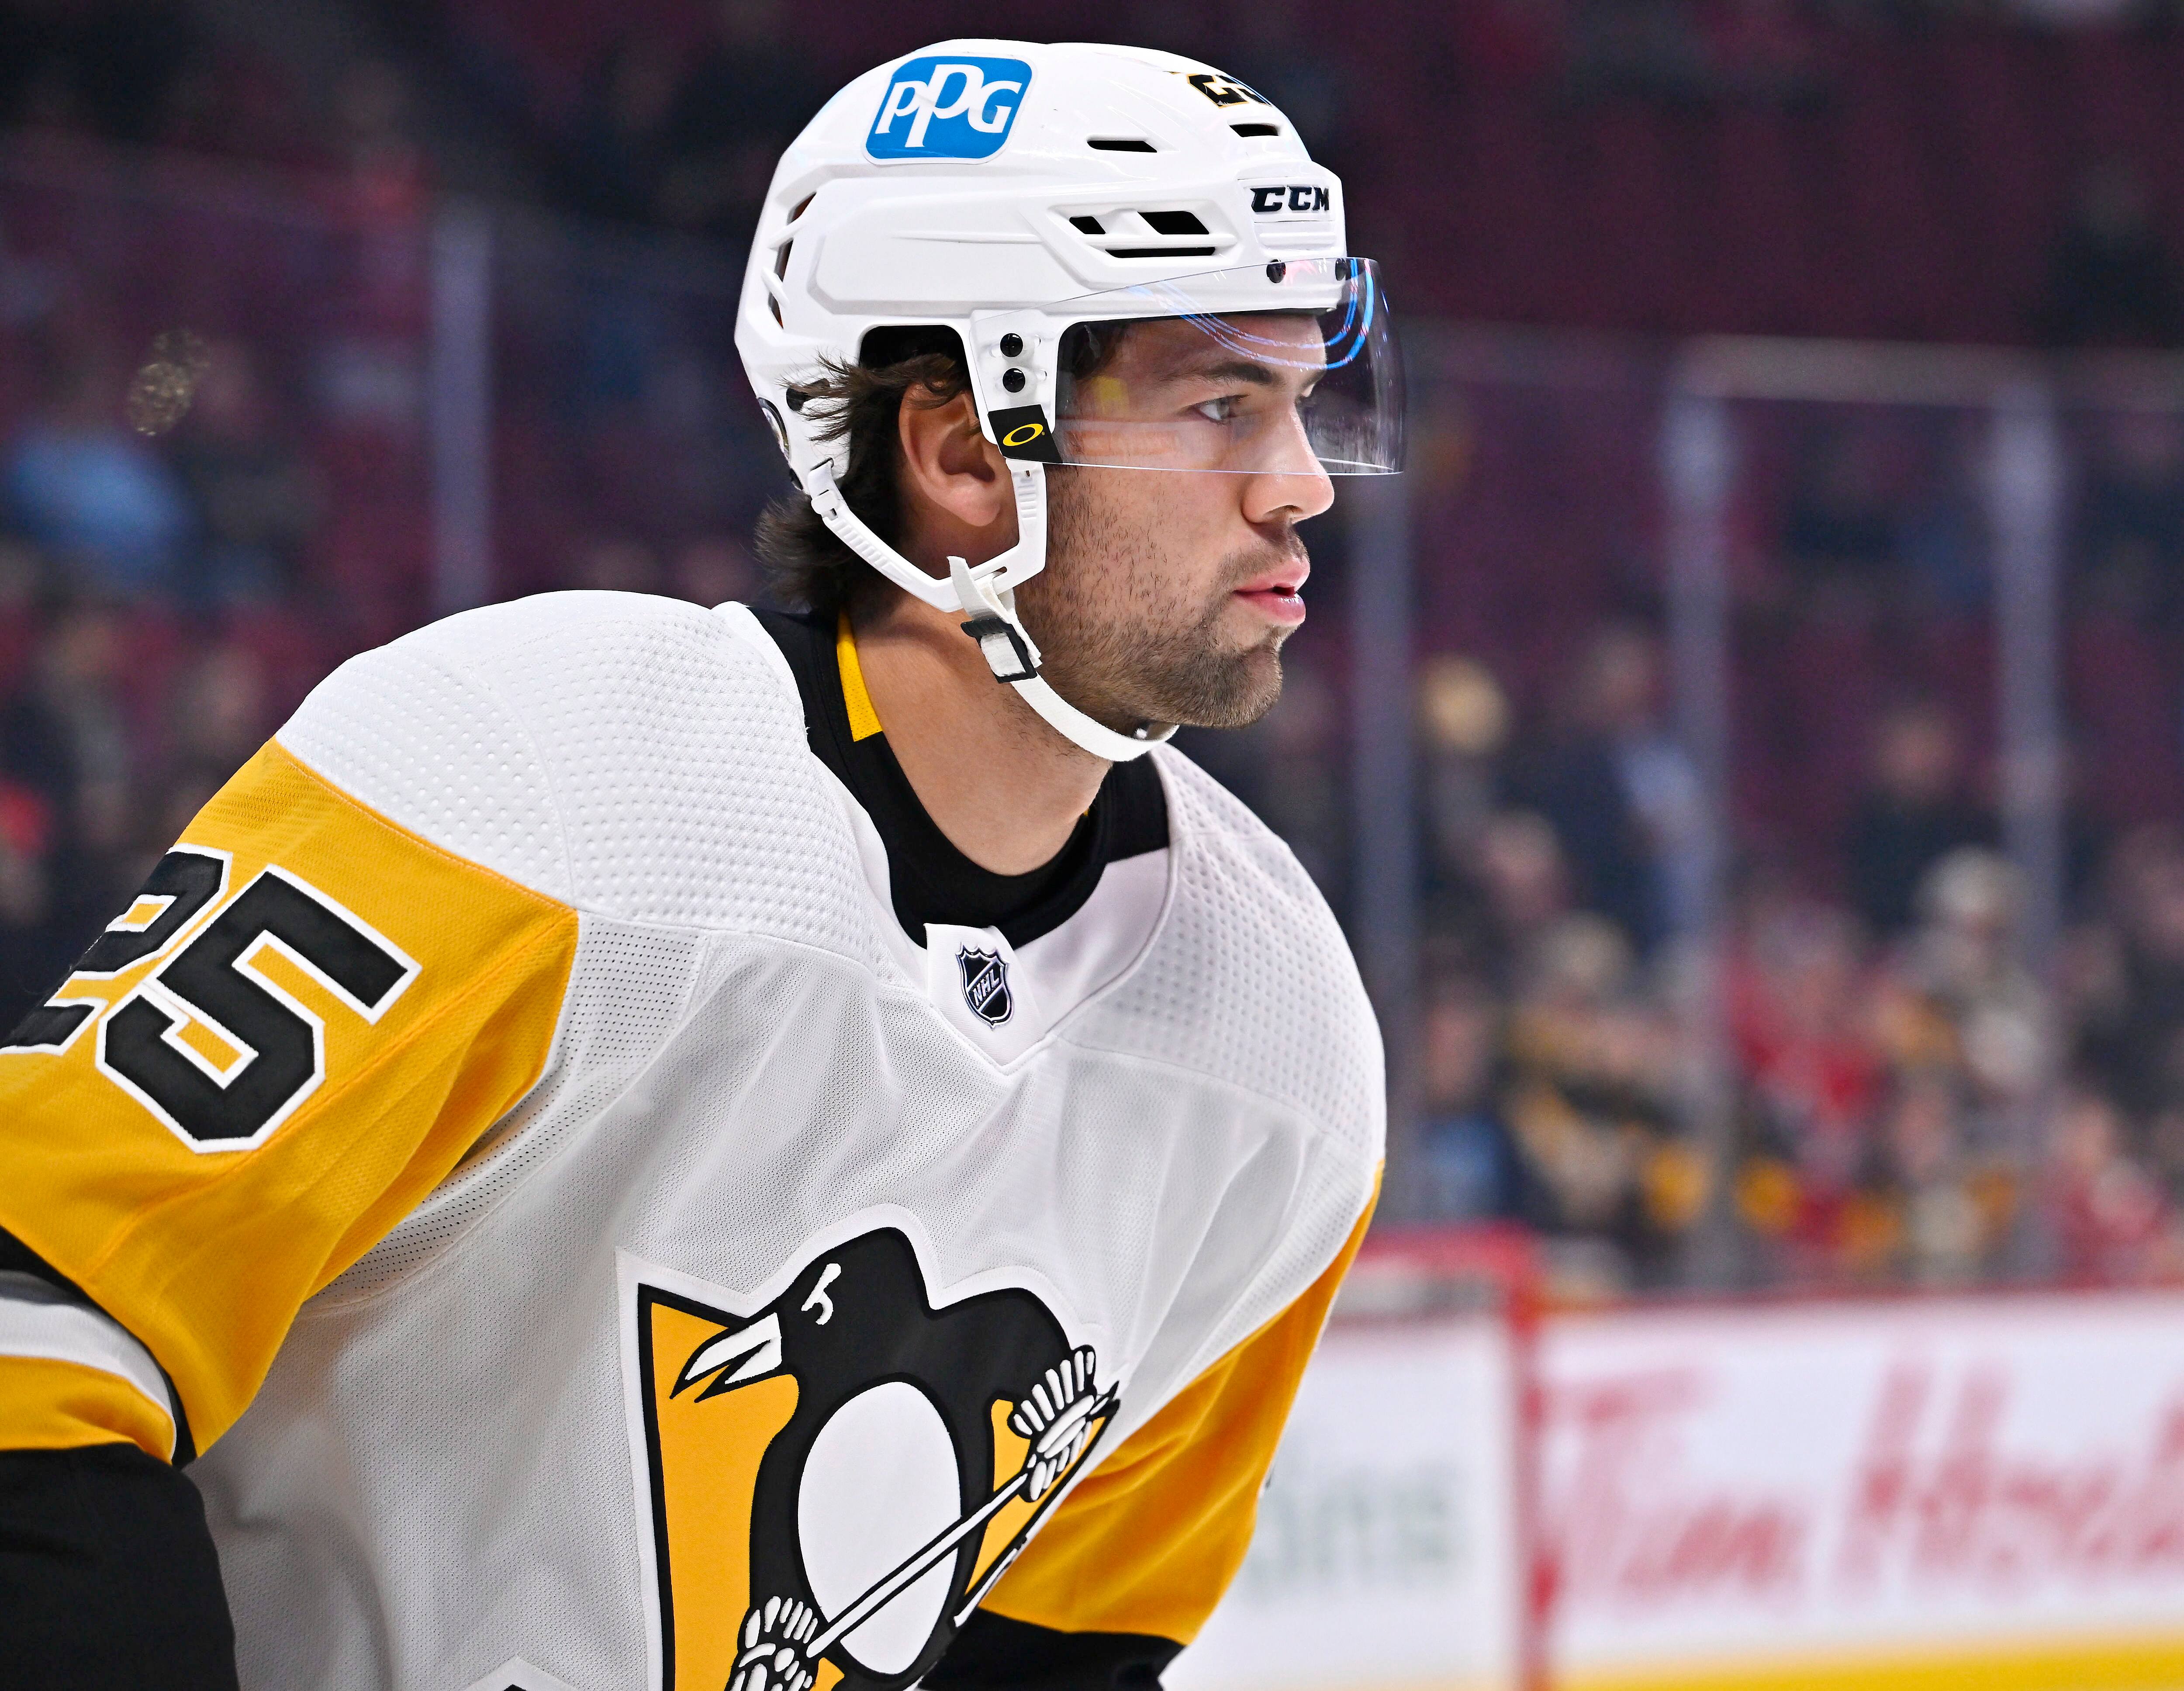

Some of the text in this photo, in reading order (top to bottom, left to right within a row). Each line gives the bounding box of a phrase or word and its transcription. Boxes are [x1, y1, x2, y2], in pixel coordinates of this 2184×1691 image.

[874, 64, 1023, 148] PPG
[1250, 186, 1330, 212] CCM
[0, 843, 423, 1154] 25
[973, 968, 999, 1006] NHL
